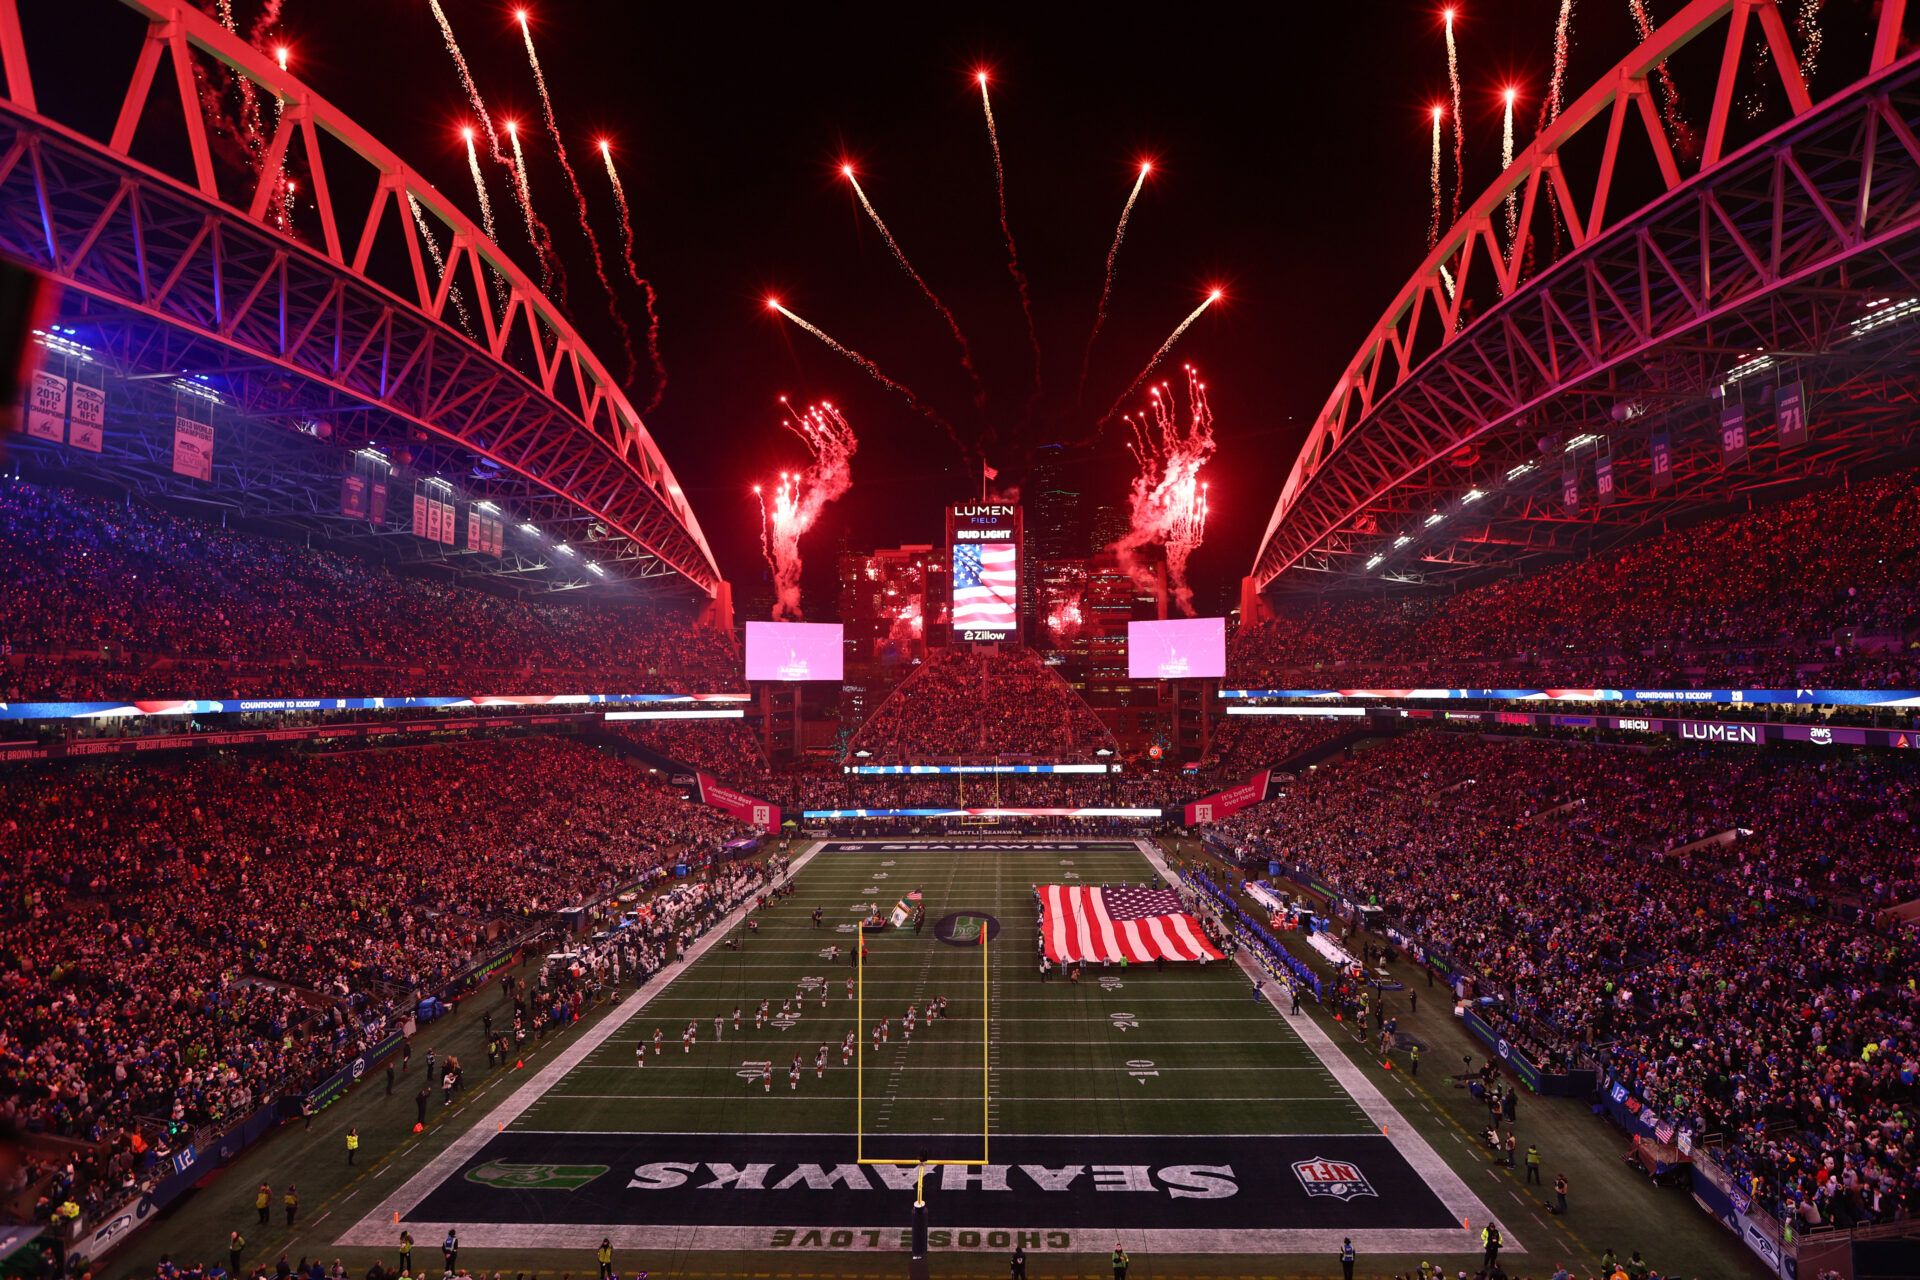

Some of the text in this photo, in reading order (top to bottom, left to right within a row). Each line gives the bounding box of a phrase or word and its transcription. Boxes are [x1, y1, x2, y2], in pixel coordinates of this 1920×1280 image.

[36, 387, 62, 403] 2013
[31, 405, 65, 419] CHAMPIONS
[39, 398, 57, 410] NFC
[76, 400, 100, 414] 2014
[72, 416, 104, 430] CHAMPIONS
[80, 411, 97, 421] NFC
[1780, 407, 1802, 433] 71
[177, 418, 213, 435] 2013 WORLD
[177, 425, 213, 441] CHAMPIONS
[1724, 427, 1745, 452] 96
[1654, 453, 1668, 474] 12
[1598, 474, 1613, 495] 80
[1564, 487, 1578, 506] 45
[954, 506, 1014, 516] LUMEN
[957, 530, 1012, 539] BUD LIGHT
[974, 631, 1006, 640] Zillow
[1685, 692, 1713, 700] KICKOFF
[240, 701, 285, 709] COUNTDOWN
[296, 700, 321, 708] KICKOFF
[1682, 723, 1756, 743] LUMEN
[1810, 727, 1832, 738] aws
[8, 748, 32, 760] BROWN
[71, 744, 86, 755] PETE
[87, 743, 107, 754] GROSS
[708, 786, 752, 806] America's Best
[1222, 785, 1255, 802] It's better
[1224, 792, 1256, 807] over here
[1110, 1012, 1140, 1028] 20
[1126, 1060, 1160, 1077] 10
[1612, 1086, 1625, 1102] 12
[178, 1148, 194, 1170] 12
[1300, 1162, 1359, 1181] NFL
[626, 1162, 1240, 1200] SEAHAWKS
[770, 1229, 1071, 1249] CHOOSE LOVE
